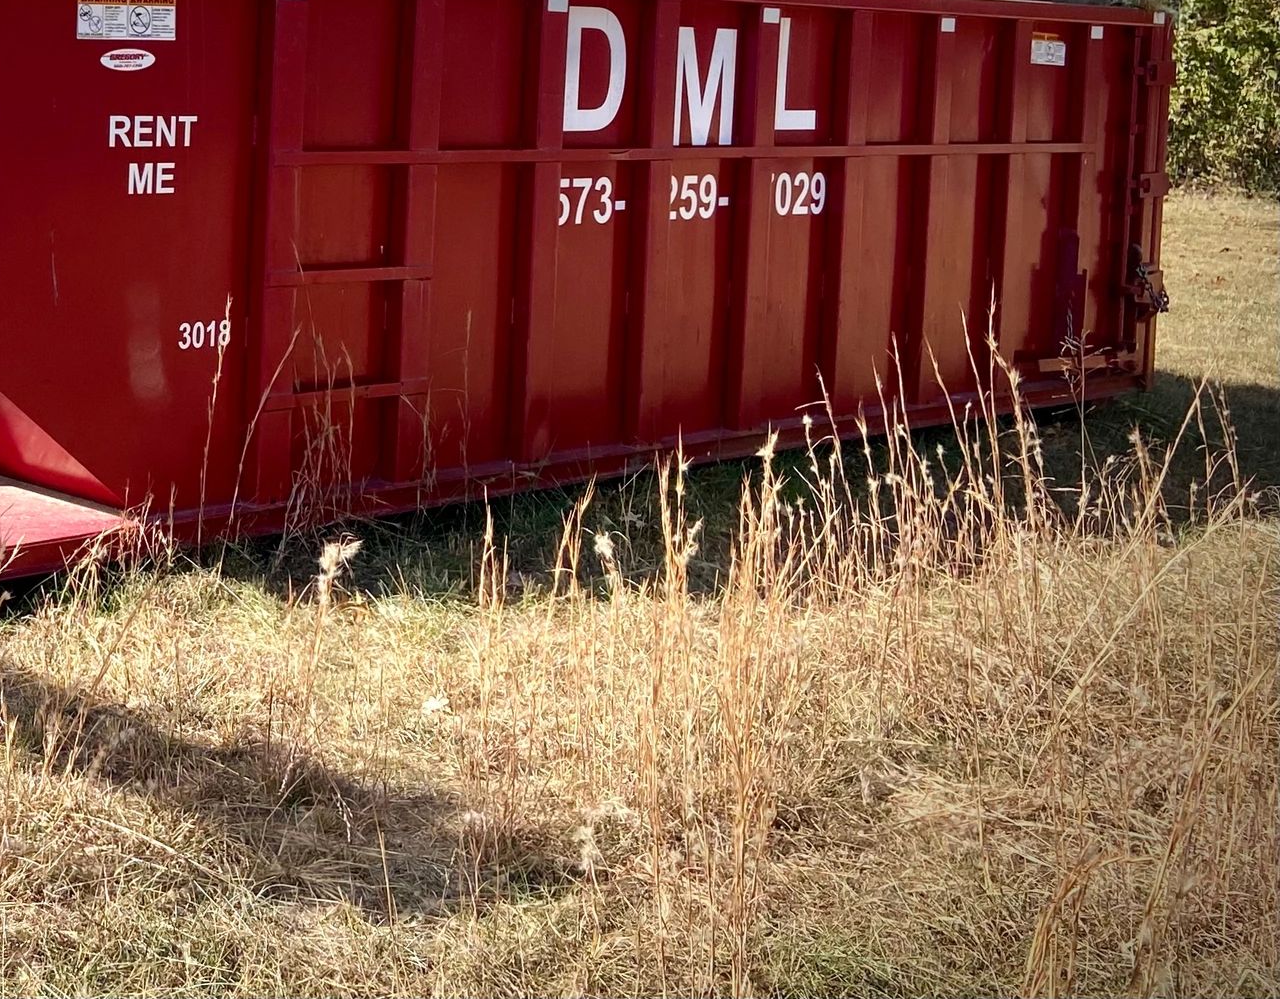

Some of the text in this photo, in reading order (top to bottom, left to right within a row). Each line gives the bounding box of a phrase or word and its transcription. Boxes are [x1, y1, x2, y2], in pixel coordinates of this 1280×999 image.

[562, 6, 816, 146] D M L
[108, 115, 198, 147] RENT
[127, 162, 176, 195] ME
[771, 172, 826, 216] 029
[178, 320, 231, 350] 3018
